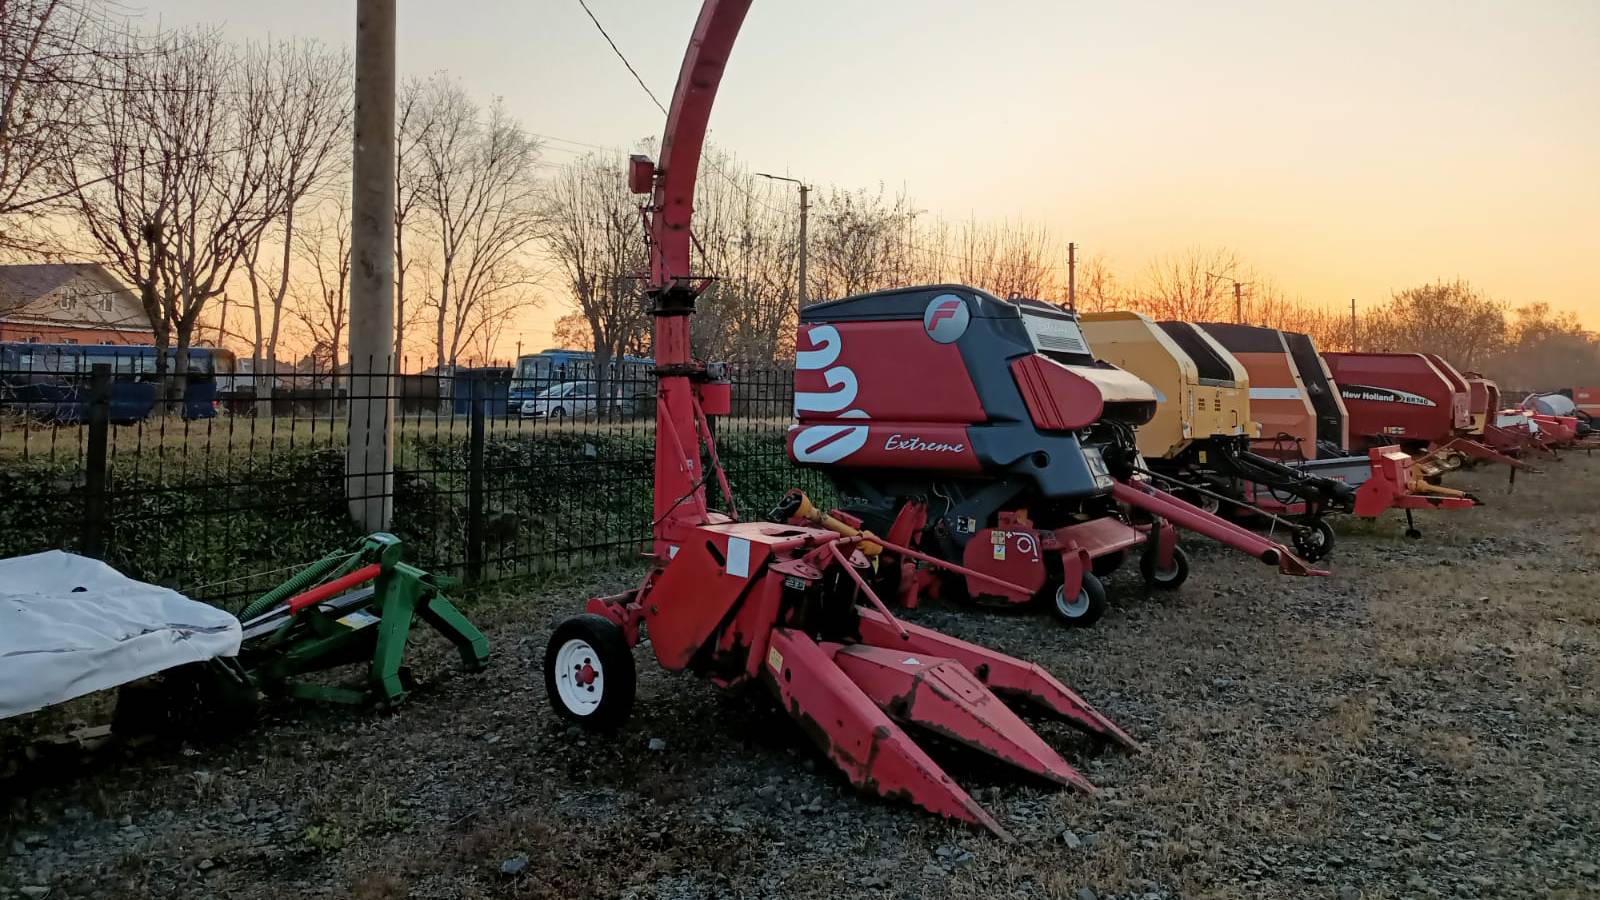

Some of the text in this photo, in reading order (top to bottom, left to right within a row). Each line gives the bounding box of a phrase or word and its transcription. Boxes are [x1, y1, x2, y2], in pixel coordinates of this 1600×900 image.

[1342, 390, 1361, 399] New
[1362, 391, 1395, 402] Holland
[884, 434, 965, 453] Extreme
